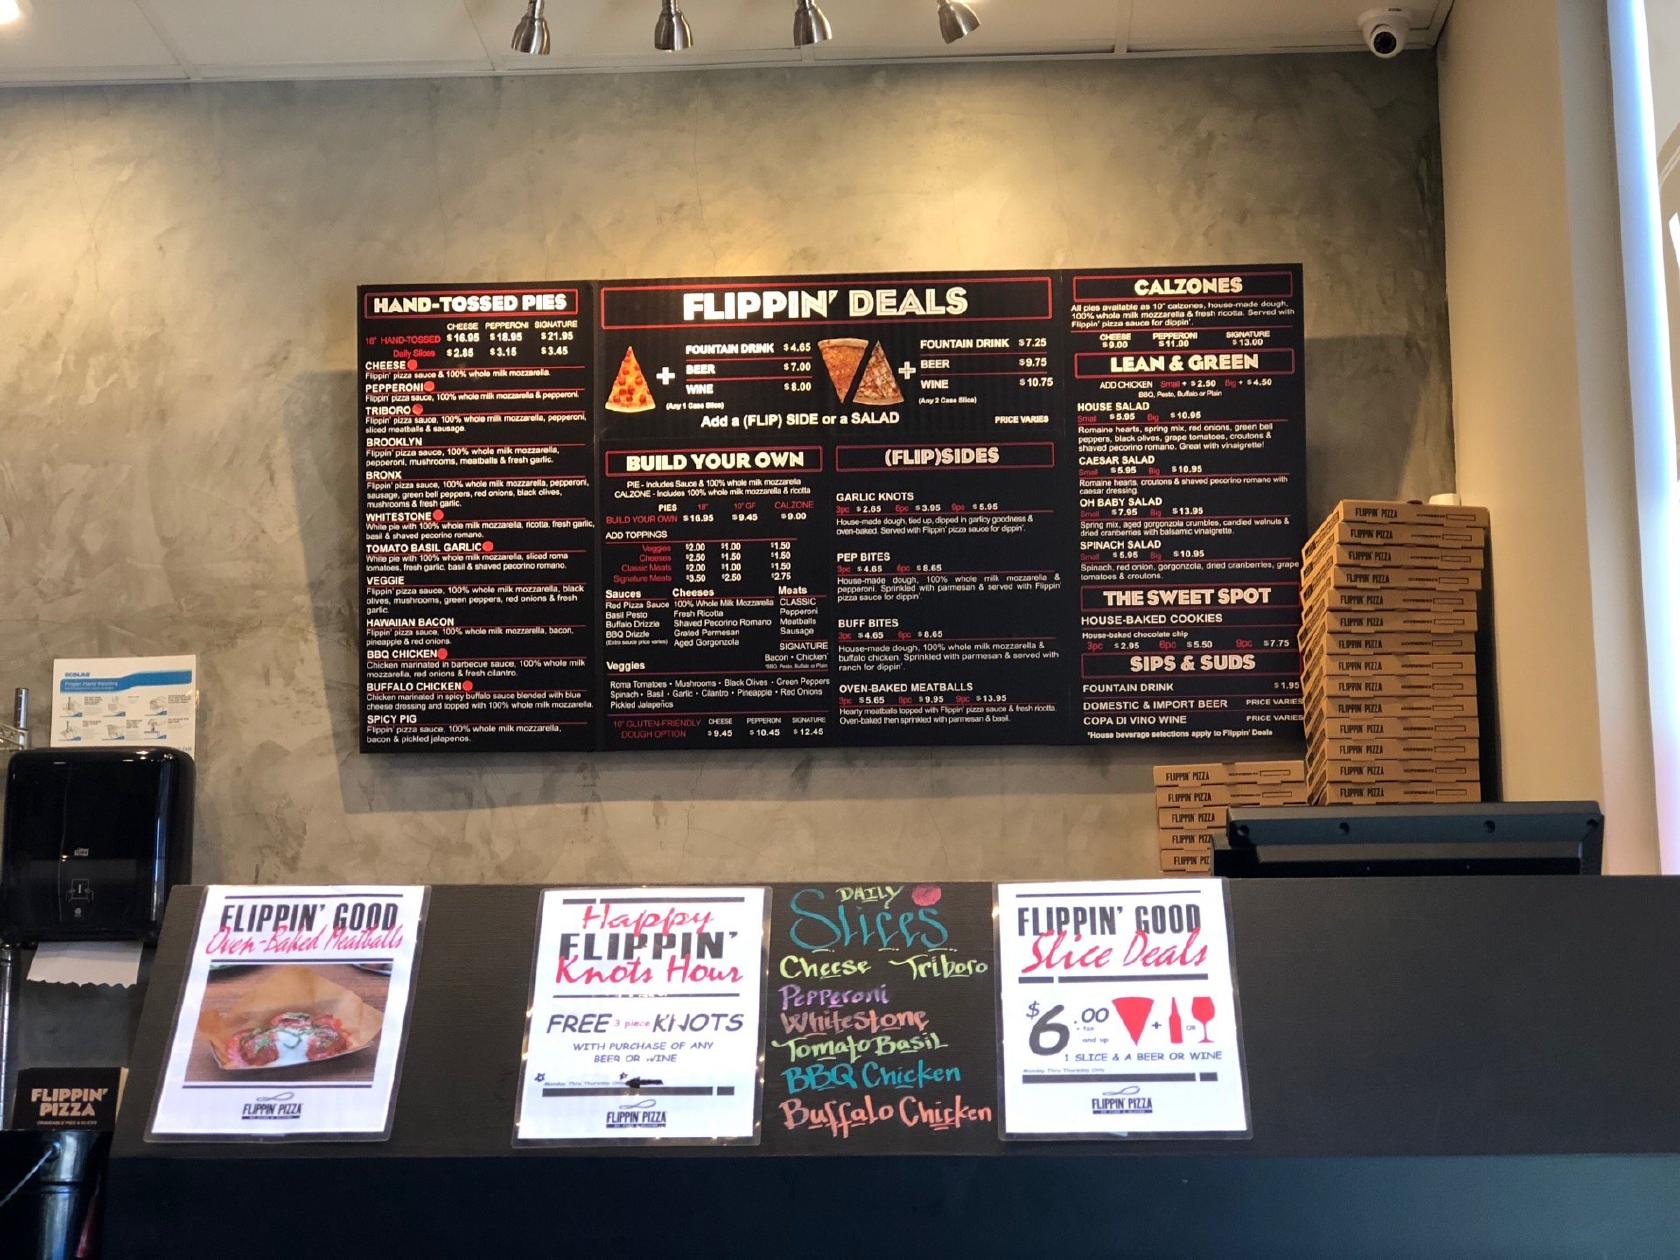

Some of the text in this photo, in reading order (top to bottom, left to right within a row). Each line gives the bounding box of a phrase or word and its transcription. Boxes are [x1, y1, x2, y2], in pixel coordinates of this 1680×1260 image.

[1134, 277, 1243, 296] CALZONES
[374, 294, 567, 313] HAND-TOSSED PIES
[683, 287, 968, 321] FLIPPIN' DEALS
[447, 320, 578, 329] CHEESE PEPPERONI SIGNATURE
[686, 343, 774, 354] FOUNTAIN DRINK
[920, 339, 1009, 349] FOUNTAIN DRINK
[365, 361, 406, 370] CHEESE
[920, 359, 950, 369] BEER
[1110, 354, 1259, 372] LEAN & GREEN
[686, 364, 715, 374] BEER
[365, 383, 424, 393] PEPPERONI
[686, 384, 714, 394] WINE
[921, 380, 949, 389] WINE
[365, 406, 411, 415] TRIBORO
[1077, 402, 1150, 412] HOUSE SALAD
[701, 412, 899, 429] Add a (FLIP) SIDE or a SALAD
[1021, 415, 1049, 423] VARIES
[366, 438, 423, 447] BROOKLYN
[626, 452, 804, 471] BUILD YOUR OWN
[885, 447, 999, 467] (FLIP)SIDES
[1079, 455, 1155, 465] CAESAR SALAD
[366, 470, 402, 479] BRONX
[836, 492, 914, 501] GARLIC KNOTS
[1080, 497, 1163, 507] OH BABY SALAD
[366, 512, 432, 522] WHITESTONE
[1381, 509, 1397, 519] PIZZA
[605, 530, 668, 539] ADD TOPPINGS
[366, 542, 482, 553] TOMATO BASIL GARLIC
[1080, 540, 1161, 550] SPINACH SALAD
[837, 552, 890, 562] PEP BITES
[367, 576, 404, 585] VEGGIE
[605, 590, 641, 599] Sauces
[672, 588, 714, 597] Cheeses
[779, 586, 807, 595] Meats
[1103, 588, 1272, 606] THE SWEET SPOT
[367, 618, 454, 627] HAWAIIAN BACON
[838, 619, 899, 628] BUFF BITES
[1081, 613, 1223, 626] HOUSE-BAKED COOKIES
[367, 650, 437, 659] BBQ CHICKEN
[606, 661, 645, 672] Veggies
[1130, 654, 1256, 672] SIPS & SUDS
[367, 682, 462, 691] BUFFALO CHICKEN
[839, 683, 973, 693] OVEN-BAKED MEATBALLS
[1082, 683, 1174, 693] FOUNTAIN DRINK
[1083, 699, 1228, 711] DOMESTIC & IMPORT BEER
[367, 714, 417, 724] SPICY PIG
[1083, 715, 1188, 726] COPA DI VINO WINE
[1192, 771, 1209, 780] PIZZA
[1198, 813, 1215, 822] PIZZA
[835, 885, 904, 909] DAILY
[219, 903, 399, 933] FLIPPIN' GOOD
[582, 903, 714, 938] Happy
[789, 889, 949, 950] Slices
[1017, 903, 1201, 936] FLIPPIN' GOOD
[205, 923, 404, 956] Oven-Baked Meatballs
[558, 931, 738, 961] FLIPPIN'
[1021, 927, 1208, 973] Slice Deals
[556, 954, 743, 984] Knots Hour
[779, 954, 989, 980] Cheese Triboro
[778, 984, 890, 1011] Pepperoni
[546, 1014, 613, 1034] FREE
[624, 1019, 650, 1029] piece
[573, 1041, 714, 1051] WITH PURCHASE OF ANY
[771, 1035, 871, 1063] Tomato
[626, 1054, 640, 1062] OR
[1075, 1053, 1108, 1062] SLICE
[1112, 1053, 1119, 1061] &
[1124, 1053, 1132, 1061] A
[1137, 1052, 1164, 1061] BEER
[1169, 1052, 1184, 1060] OR
[1190, 1051, 1222, 1060] WINE
[781, 1059, 961, 1094] BBQ Chicken
[31, 1088, 109, 1102] FLIPPIN'
[1128, 1097, 1153, 1109] PIZZA
[40, 1102, 95, 1116] PIZZA
[277, 1103, 302, 1115] PIZZA
[641, 1111, 667, 1123] PIZZA
[778, 1095, 992, 1138] Buffalo Chicken
